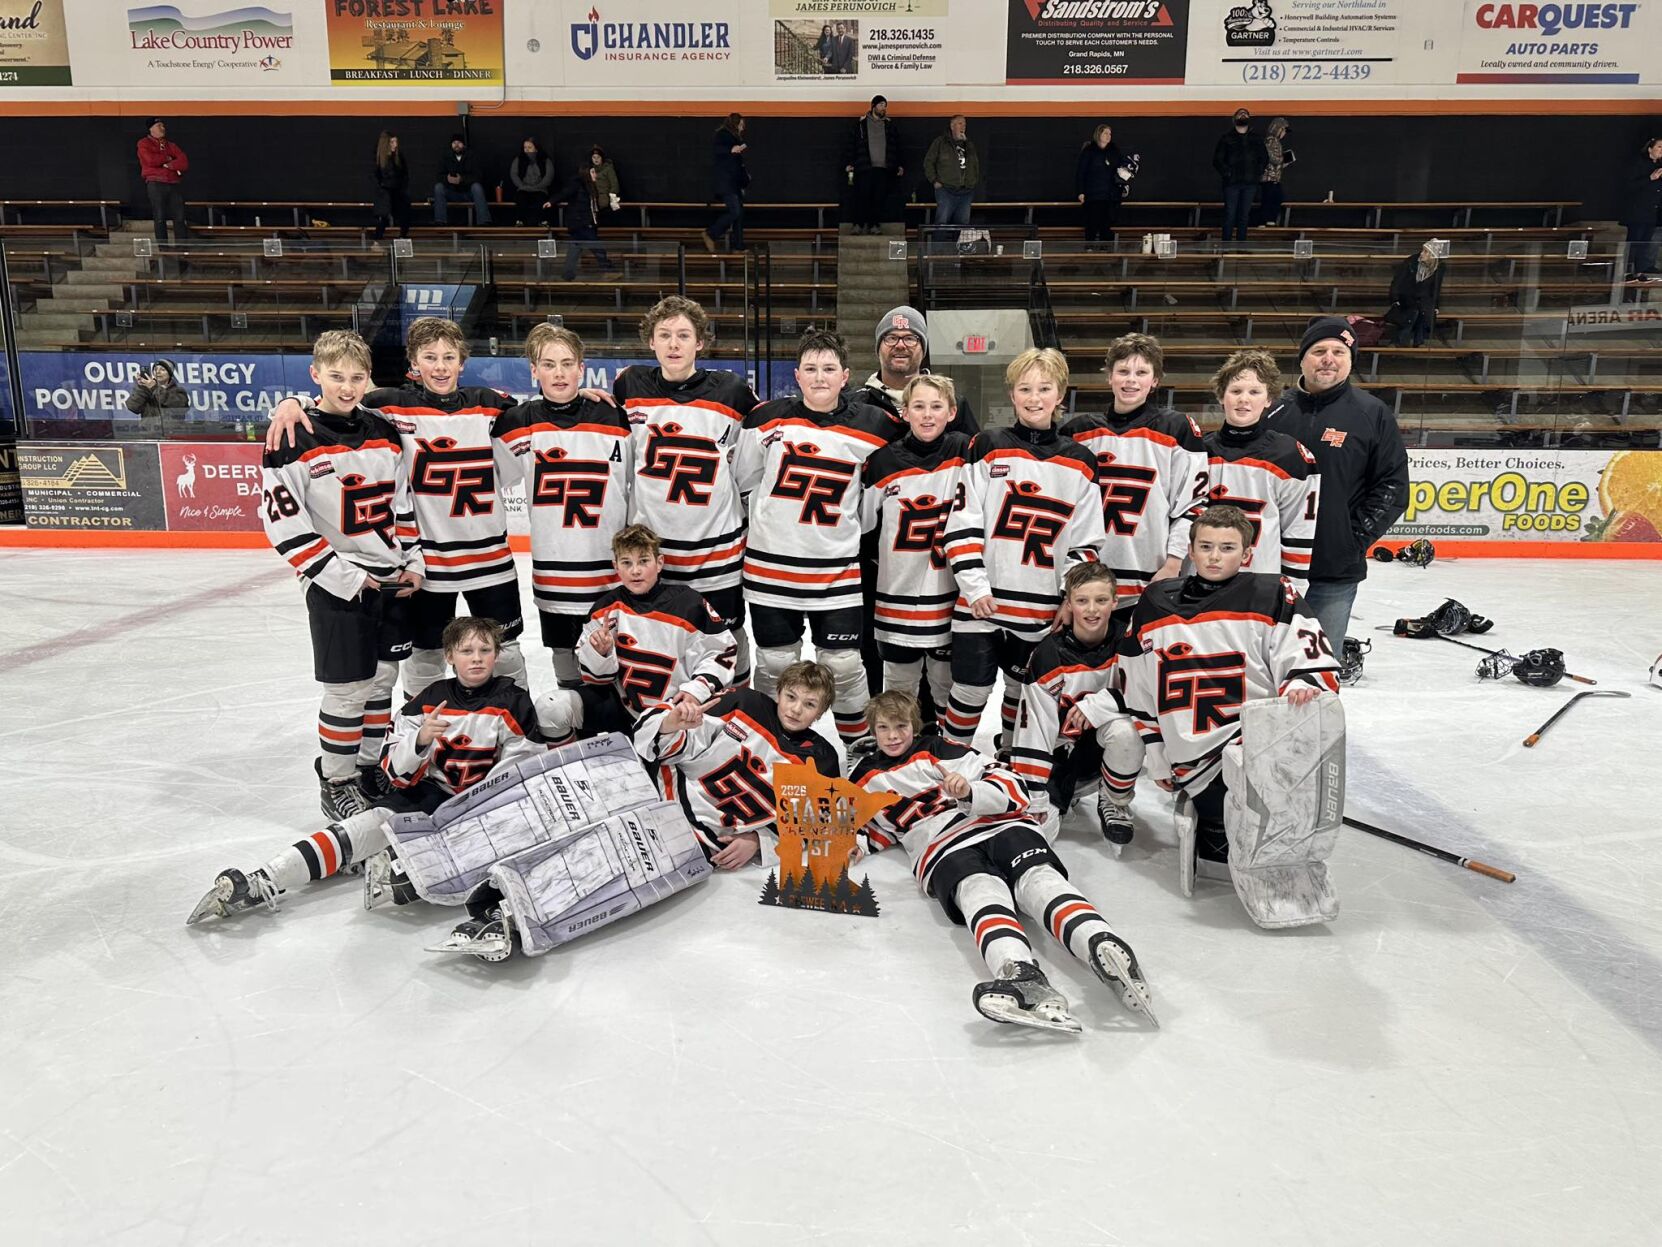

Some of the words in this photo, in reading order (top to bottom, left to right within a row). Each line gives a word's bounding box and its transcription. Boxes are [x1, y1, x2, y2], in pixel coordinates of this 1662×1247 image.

[335, 0, 427, 17] FOREST
[433, 0, 494, 16] LAKE
[795, 3, 828, 11] JAMES
[830, 3, 896, 11] PERUNOVICH
[1292, 1, 1319, 9] Serving
[1338, 0, 1377, 9] Northland
[365, 20, 416, 30] Restaurant
[429, 20, 464, 31] Lounge
[1038, 20, 1077, 28] Distributing
[1080, 20, 1104, 28] Quality
[1371, 14, 1396, 22] Systems
[1476, 4, 1637, 36] CARQUEST
[131, 30, 169, 49] Lake
[172, 31, 240, 54] Country
[243, 30, 293, 49] Power
[604, 23, 730, 48] CHANDLER
[869, 29, 935, 41] 218.326.1435
[605, 52, 676, 61] INSURANCE
[681, 52, 731, 61] AGENCY
[1088, 51, 1112, 59] Rapids,
[1254, 48, 1270, 56] Visit
[1283, 48, 1291, 56] at
[1506, 43, 1547, 55] AUTO
[1549, 43, 1599, 55] PARTS
[147, 60, 154, 68] A
[155, 60, 191, 68] Touchstone
[217, 60, 257, 70] Cooperative
[900, 63, 920, 71] Family
[1063, 65, 1129, 74] 218.326.0567
[1481, 60, 1506, 69] Locally
[1508, 60, 1532, 68] owned
[1533, 60, 1548, 68] and
[1550, 60, 1592, 69] community
[1593, 60, 1619, 68] driven.
[345, 71, 400, 79] BREAKFAST
[409, 71, 443, 79] LUNCH
[453, 71, 491, 79] DINNER
[1243, 64, 1286, 83] (218)
[1292, 64, 1371, 80] 722-4439
[151, 362, 256, 385] NERGY
[35, 388, 131, 410] POWER
[718, 425, 731, 445] A
[609, 440, 622, 462] A
[1456, 457, 1502, 469] Better
[1505, 457, 1565, 469] Choices.
[202, 464, 263, 479] DEER
[264, 485, 300, 523] 28
[1404, 472, 1589, 523] perOne
[209, 505, 246, 520] Simple
[1304, 491, 1317, 520] 1
[28, 516, 132, 526] CONTRACTOR
[1502, 514, 1581, 531] FOODS
[1386, 525, 1483, 535] peronefoods.com
[827, 633, 859, 641] CCM
[471, 772, 509, 797] BAUER
[1324, 761, 1340, 822] BAUER
[551, 776, 581, 821] BAUER
[628, 820, 654, 872] BAUER
[1011, 847, 1047, 868] CCM
[568, 911, 607, 933] BAUER
